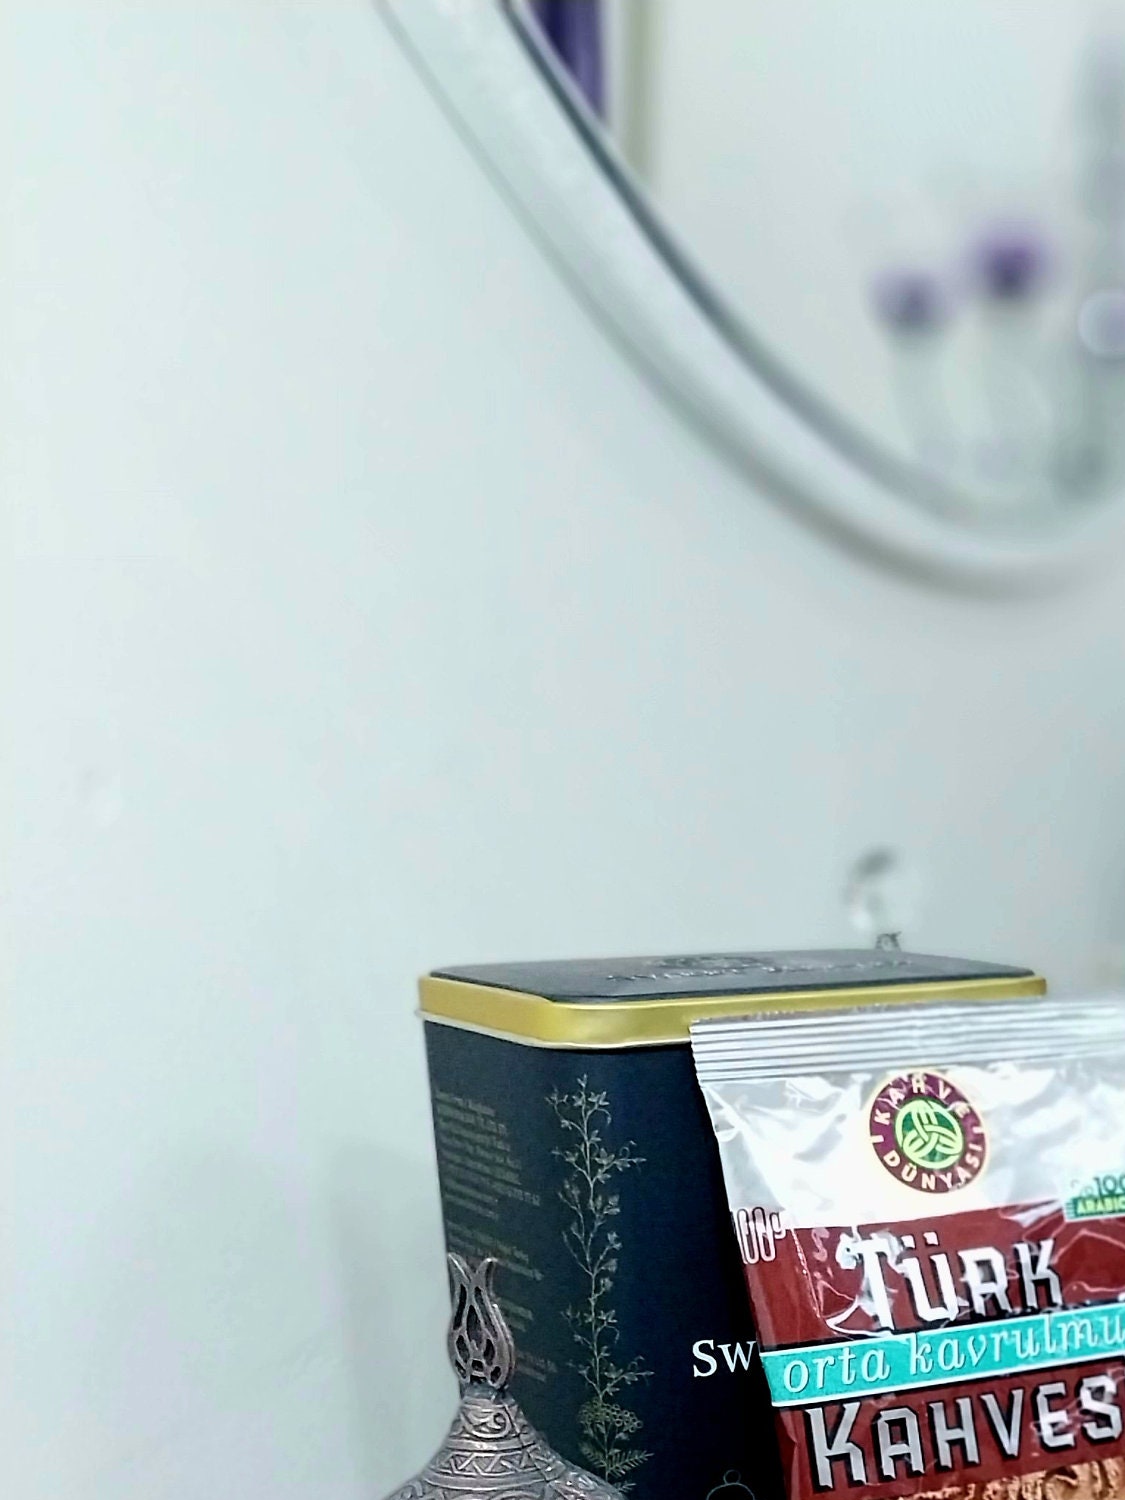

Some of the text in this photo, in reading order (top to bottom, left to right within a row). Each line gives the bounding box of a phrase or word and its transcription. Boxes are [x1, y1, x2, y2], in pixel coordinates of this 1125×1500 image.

[882, 1143, 983, 1192] DÜNYASI
[847, 1230, 1063, 1332] TÜRK
[782, 1345, 891, 1394] orta
